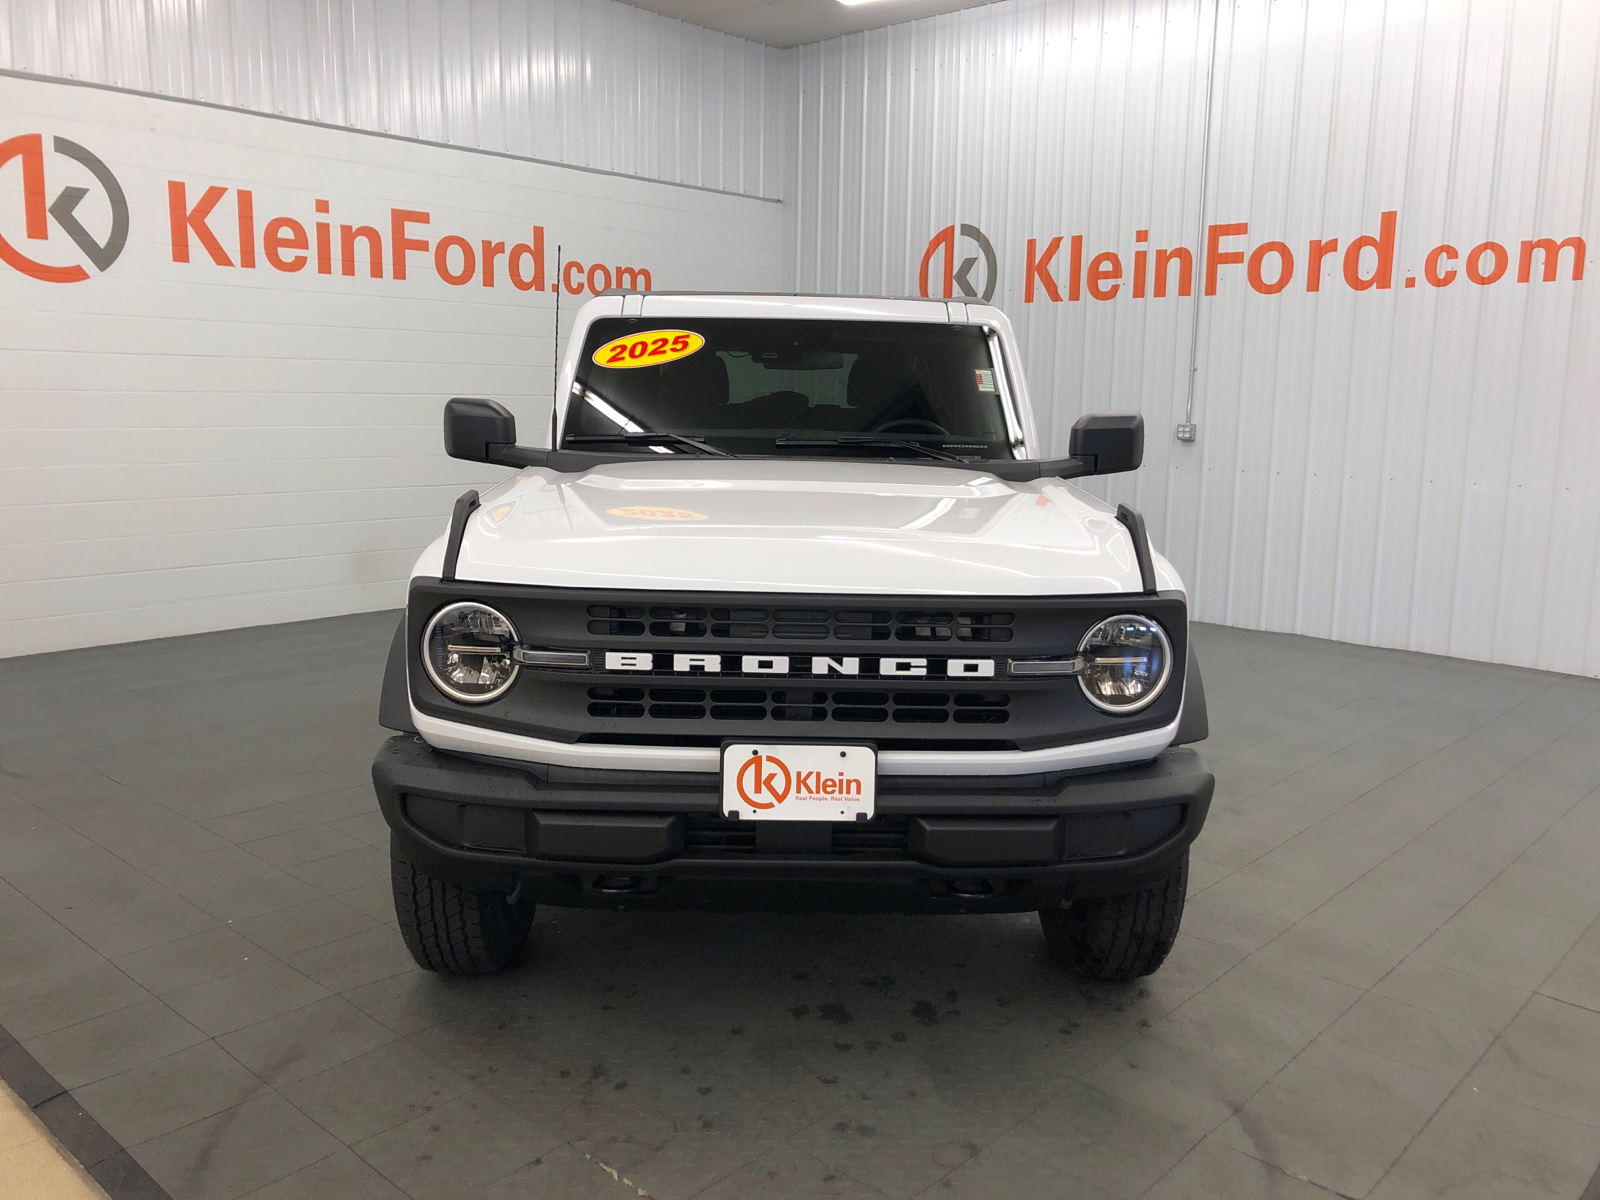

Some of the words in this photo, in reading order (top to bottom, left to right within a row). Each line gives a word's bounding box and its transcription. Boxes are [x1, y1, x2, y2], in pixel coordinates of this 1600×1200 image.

[168, 180, 652, 297] KleinFord.com
[1025, 211, 1586, 304] KleinFord.com
[606, 334, 691, 364] 2025
[605, 651, 995, 677] BRONCO
[796, 771, 862, 795] Klein
